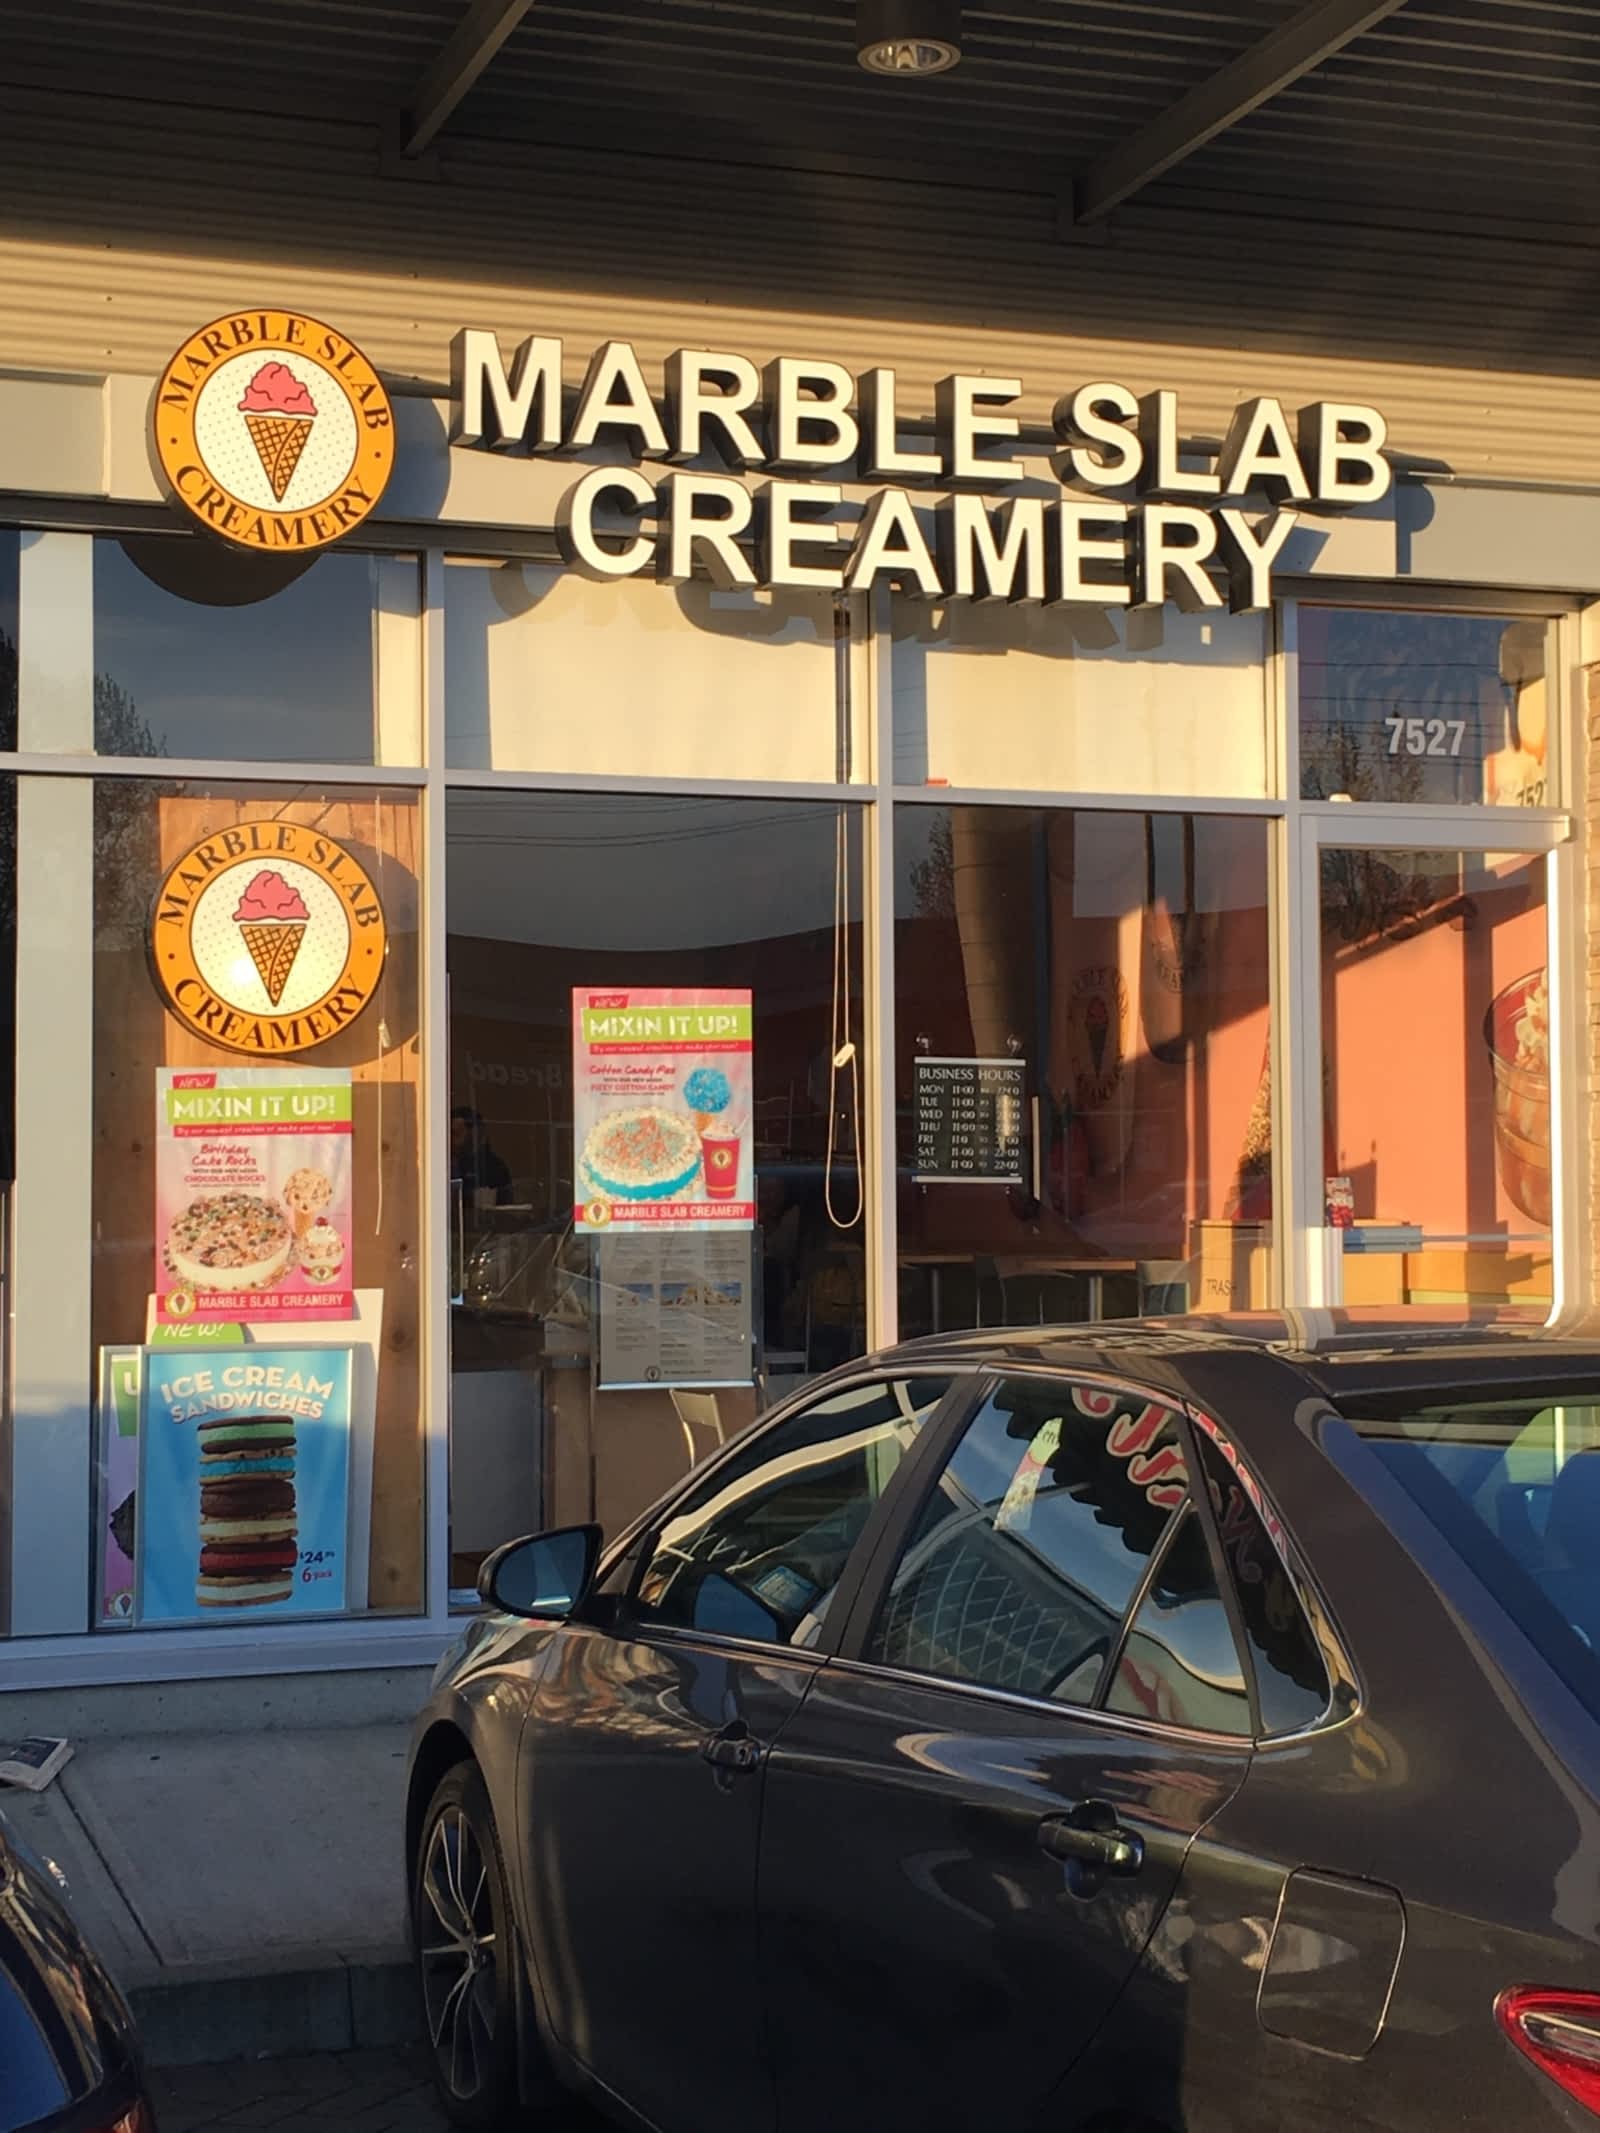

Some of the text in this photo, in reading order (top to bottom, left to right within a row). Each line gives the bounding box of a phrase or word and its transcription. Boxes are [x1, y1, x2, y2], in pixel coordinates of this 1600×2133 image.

[161, 317, 390, 432] MARBLE SLAB
[460, 327, 1391, 503] MARBLE SLAB
[174, 465, 374, 546] CREAMERY
[566, 466, 1299, 609] CREAMERY
[1384, 718, 1466, 756] 7527
[158, 826, 380, 928] MARBLE SLAB
[174, 974, 366, 1049] CREAMERY
[589, 1015, 738, 1037] MIXIN IT UP!
[919, 1067, 1021, 1081] BUSINESS HOURS
[919, 1085, 944, 1094] MON
[173, 1094, 337, 1118] MIXIN IT UP!
[920, 1096, 938, 1106] TUE
[919, 1110, 943, 1118] WED
[920, 1122, 941, 1131] THU
[918, 1134, 933, 1144] FRI
[918, 1147, 936, 1156] SAT
[191, 1154, 257, 1166] Cake Rocks
[918, 1159, 938, 1169] SUN
[614, 1205, 746, 1219] MARBLE SLAB CREAMERY
[199, 1293, 344, 1309] MARBLE SLAB CREAMERY
[164, 1322, 225, 1338] NEW!
[160, 1369, 215, 1404] ICE
[221, 1366, 335, 1400] CREAM
[170, 1391, 325, 1425] SANDWICHES
